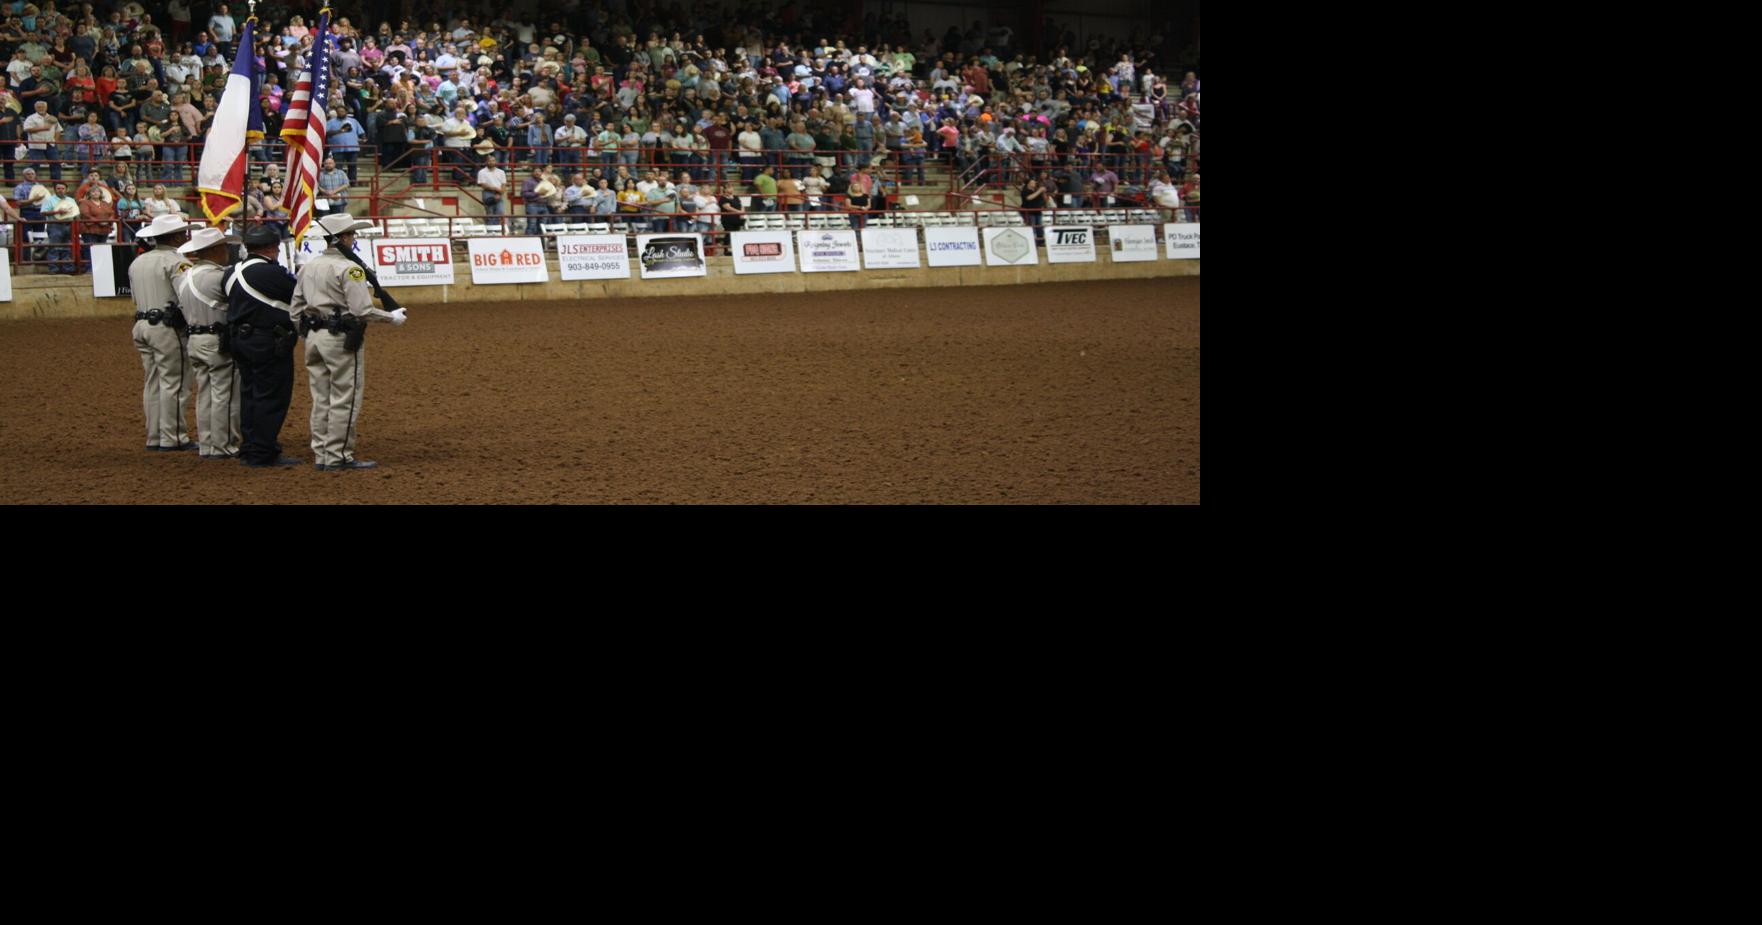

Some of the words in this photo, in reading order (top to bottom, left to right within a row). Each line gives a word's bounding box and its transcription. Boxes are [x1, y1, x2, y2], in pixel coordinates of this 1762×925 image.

[1052, 229, 1088, 245] TVEC
[561, 245, 579, 255] JLS
[579, 243, 624, 254] ENTERPRISES
[938, 241, 977, 250] CONTRACTING
[382, 246, 445, 263] SMITH
[643, 246, 665, 260] Lash
[666, 245, 695, 260] Studio
[474, 253, 497, 266] BIG
[516, 253, 541, 265] RED
[399, 263, 405, 271] &
[407, 263, 431, 271] SONS
[567, 261, 621, 271] 903-849-0955
[416, 272, 452, 280] EQUIPMENT
